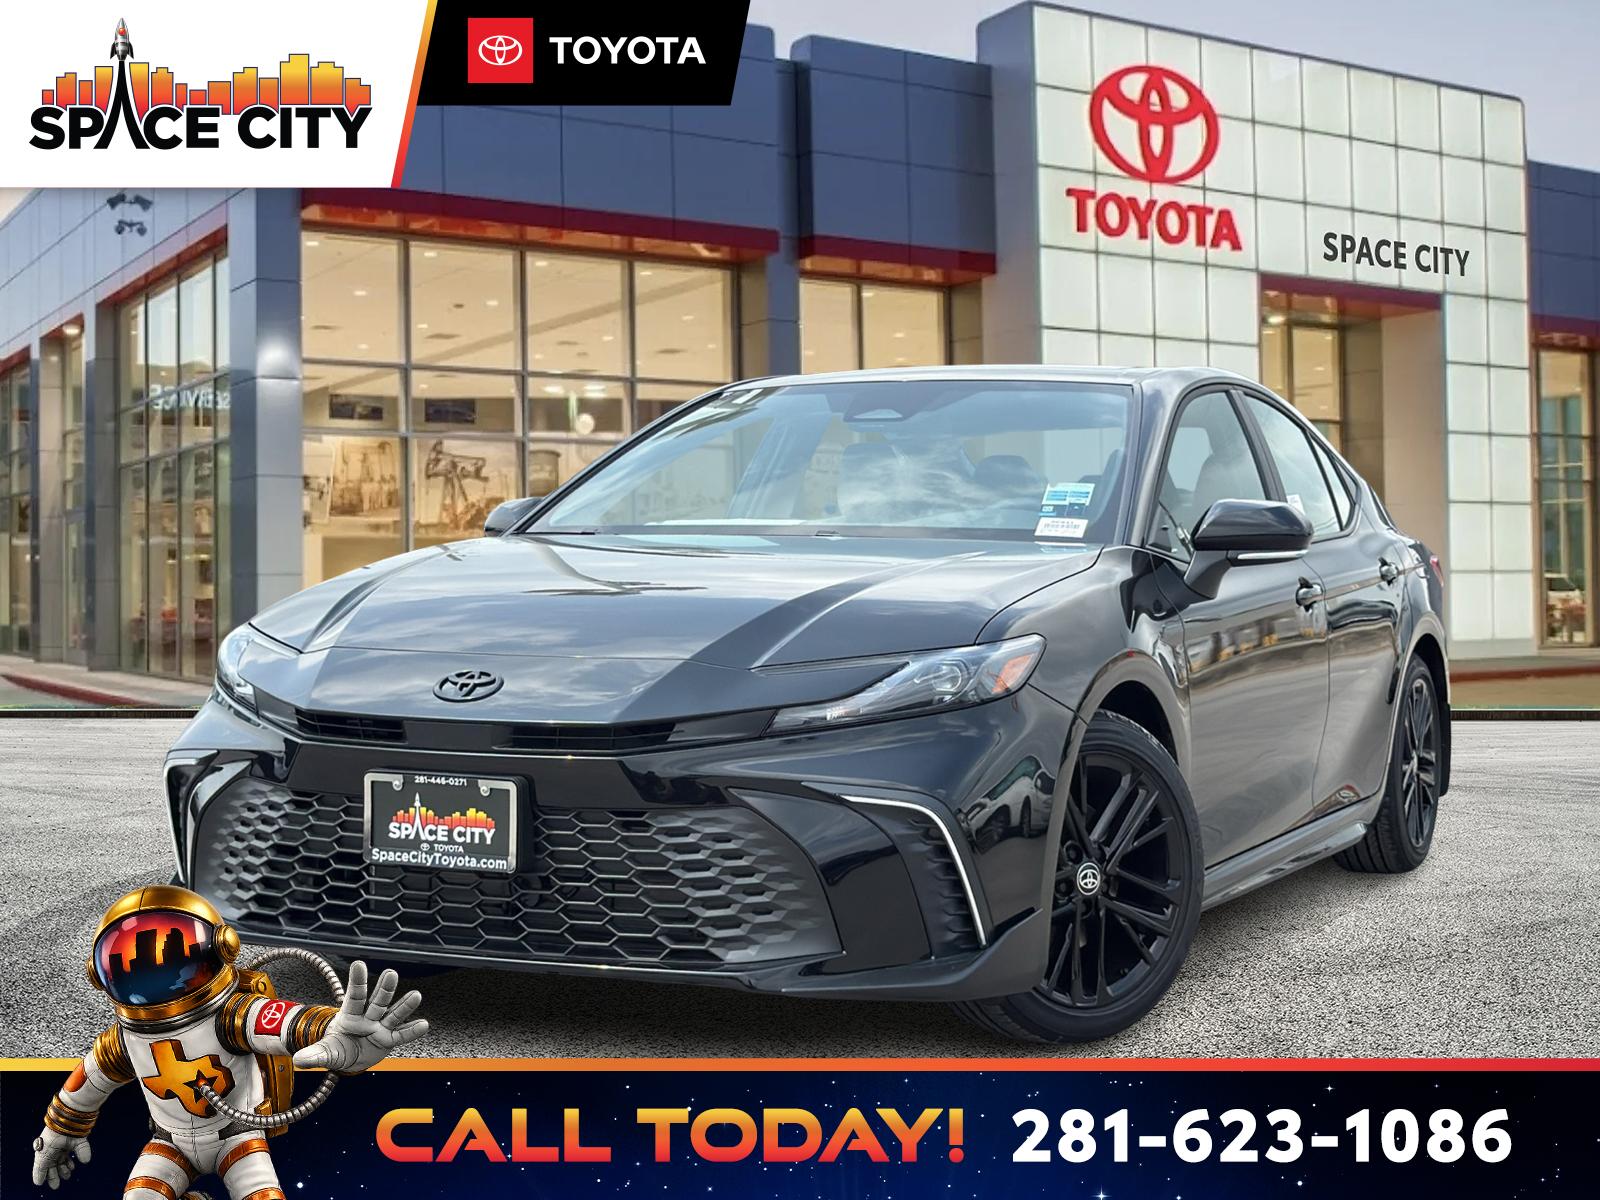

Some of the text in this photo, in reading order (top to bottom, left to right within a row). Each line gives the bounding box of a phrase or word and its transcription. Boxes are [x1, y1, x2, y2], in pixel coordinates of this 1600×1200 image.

[1066, 188, 1243, 251] TOYOTA
[1322, 232, 1471, 277] SPACE CITY
[414, 775, 468, 787] 281-446-0271
[388, 818, 496, 845] SPACE CITY
[371, 848, 507, 870] SpaceCityToyota.com
[433, 843, 464, 854] TOYOTA
